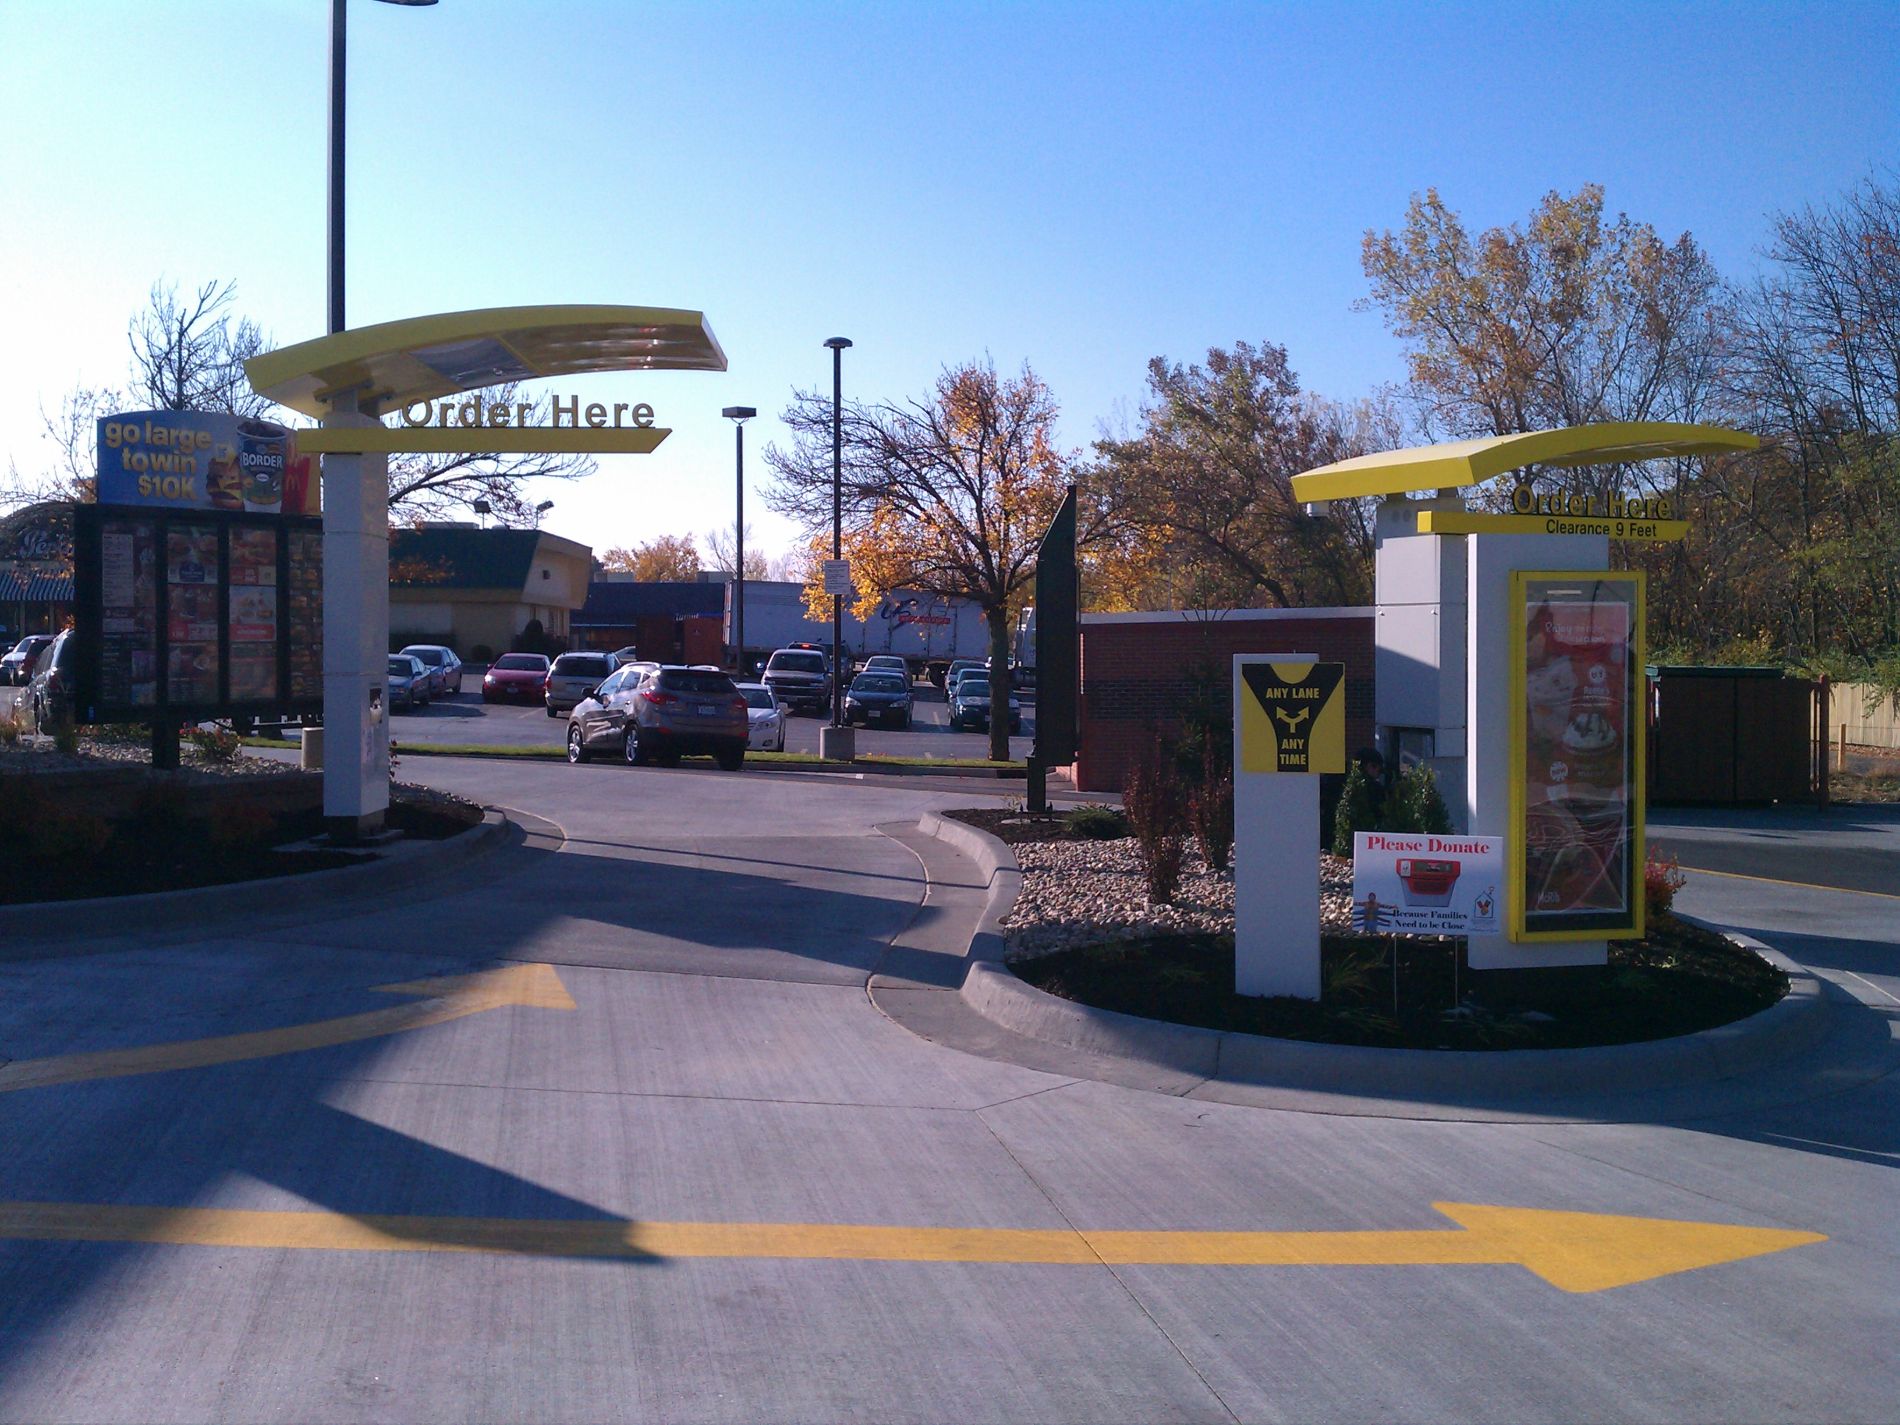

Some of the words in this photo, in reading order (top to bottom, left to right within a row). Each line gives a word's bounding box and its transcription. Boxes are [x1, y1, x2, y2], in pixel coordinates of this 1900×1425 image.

[402, 395, 532, 428] Order
[552, 395, 655, 428] Here
[105, 422, 141, 448] go
[145, 420, 212, 455] large
[122, 448, 149, 472] to
[151, 451, 197, 472] win
[242, 451, 284, 470] BORDER
[138, 473, 197, 500] $10K
[1512, 484, 1595, 516] Order
[1607, 489, 1672, 520] Here
[1546, 519, 1610, 536] Clearance
[1615, 522, 1625, 537] 9
[1629, 522, 1657, 538] Feet
[1266, 688, 1289, 699] ANY
[1292, 688, 1320, 699] LANE
[1281, 739, 1304, 750] ANY
[1280, 754, 1306, 765] TIME
[1367, 836, 1423, 852] Please
[1428, 838, 1489, 854] Donate
[1393, 909, 1428, 918] Because
[1430, 911, 1468, 920] Families
[1394, 919, 1417, 928] Need
[1418, 921, 1428, 929] to
[1429, 920, 1440, 929] be
[1441, 921, 1465, 930] Close
